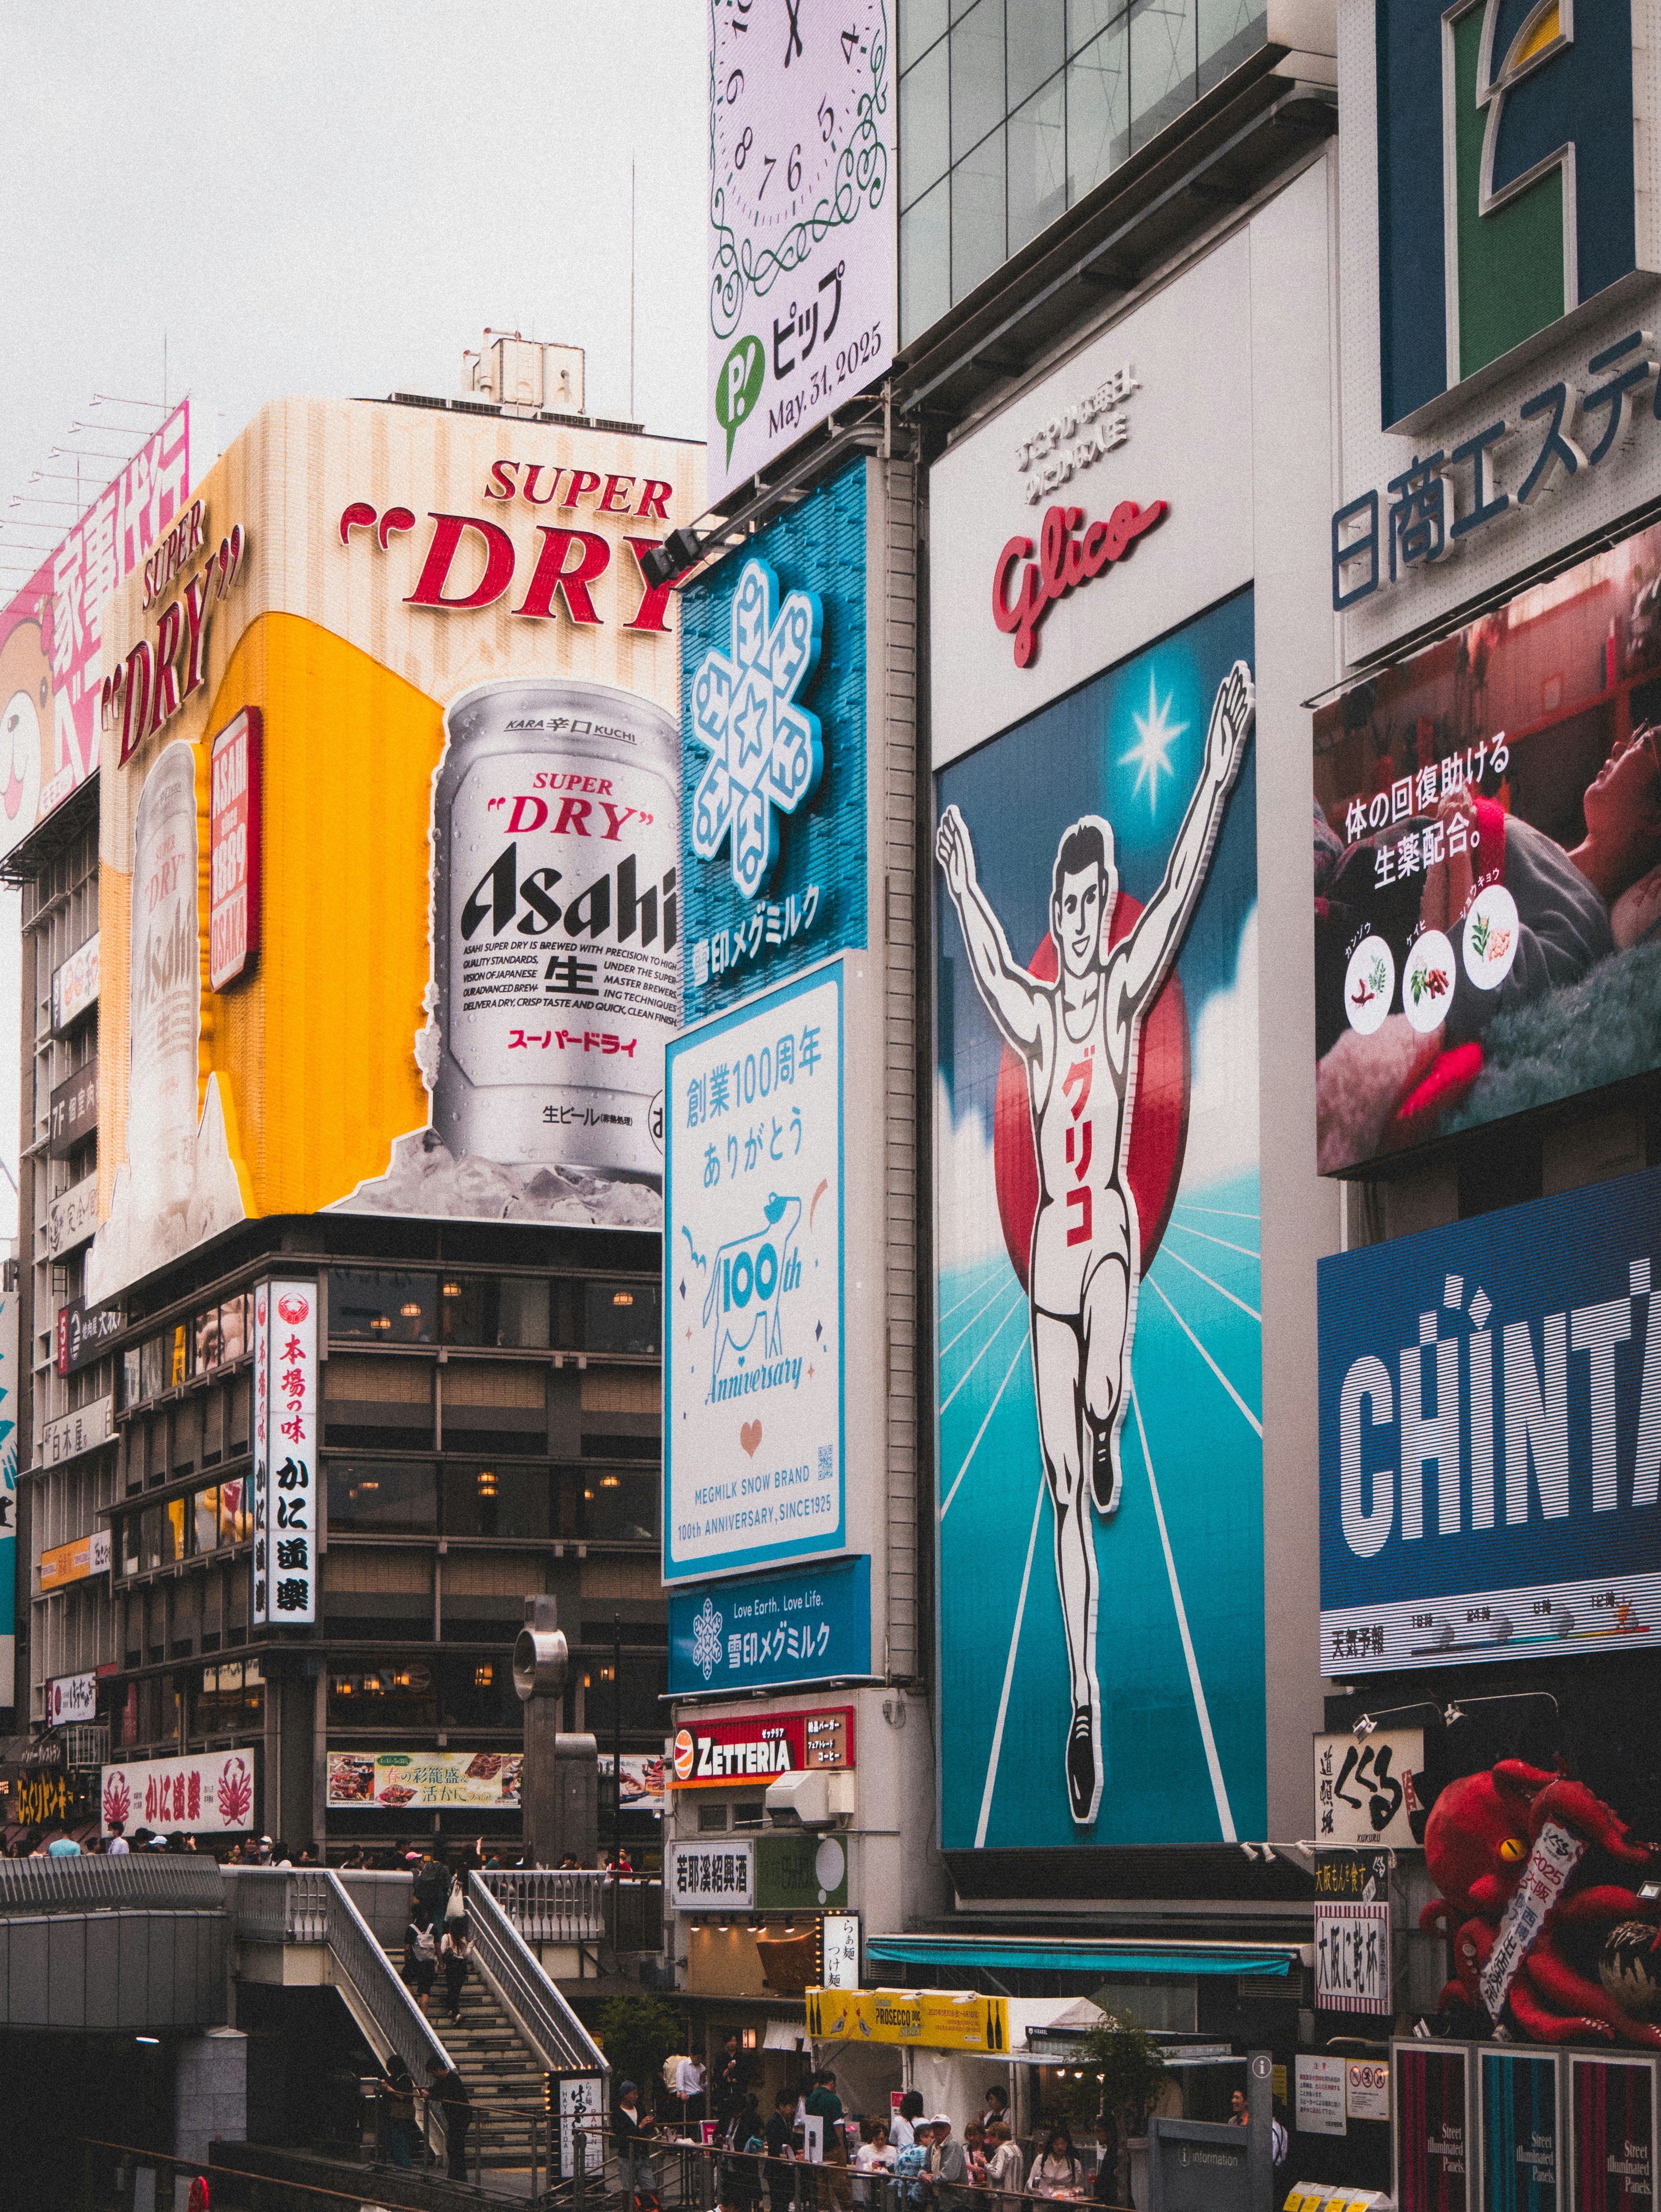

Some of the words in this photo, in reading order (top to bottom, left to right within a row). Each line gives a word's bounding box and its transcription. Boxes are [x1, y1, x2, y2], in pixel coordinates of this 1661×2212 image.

[841, 23, 859, 65] 4
[726, 69, 745, 104] 9
[817, 93, 834, 142] 5
[735, 126, 752, 170] 8
[787, 143, 802, 192] 6
[759, 157, 776, 200] 7
[773, 260, 845, 380] ピップ
[769, 391, 808, 438] May.
[810, 364, 833, 406] 31,
[836, 322, 882, 384] 2025
[484, 460, 673, 520] SUPER
[1331, 329, 1661, 612] 日商エステ
[52, 407, 186, 677] 家事代行
[142, 499, 207, 613] SUPER
[992, 500, 1167, 669] Glico
[505, 718, 544, 731] KARA
[547, 716, 592, 735] 辛口
[593, 724, 637, 743] KUCHI
[213, 733, 247, 818] ASAHI
[533, 772, 614, 796] SUPER
[1345, 731, 1509, 844] 体の回復助ける
[221, 806, 237, 837] since
[213, 823, 246, 905] 1889
[1374, 811, 1480, 890] 生薬配合。
[461, 842, 676, 954] Asahi
[212, 895, 244, 976] OSAKA
[692, 883, 820, 987] 雪印メグミルク
[1345, 921, 1371, 959] カンゾウ
[1406, 920, 1426, 947] ケイヒ
[463, 944, 483, 955] ASAHI
[484, 942, 509, 951] SUPER
[511, 941, 527, 950] DRY
[530, 941, 538, 949] IS
[540, 942, 577, 951] BREWED
[580, 944, 603, 954] WITH
[605, 948, 648, 962] PRECISION
[650, 956, 660, 964] TO
[661, 960, 677, 970] HIGH
[463, 957, 491, 969] QUALITY
[491, 956, 539, 966] STANDARDS,
[604, 961, 635, 974] UNDER
[637, 967, 653, 978] THE
[463, 972, 485, 983] VISION
[486, 972, 496, 980] OF
[495, 970, 537, 979] JAPANESE
[463, 988, 475, 997] OUR
[475, 985, 514, 996] ADVANCED
[544, 956, 599, 996] 生
[604, 975, 642, 990] MASTER
[463, 1000, 492, 1011] DELIVER
[498, 999, 515, 1008] DRY,
[516, 999, 542, 1007] CRISP
[543, 999, 570, 1008] TASTE
[572, 1001, 594, 1010] AND
[595, 1002, 626, 1015] QUICK,
[627, 1008, 654, 1020] CLEAN
[604, 989, 623, 999] ING
[624, 992, 677, 1012] TECHNIQUES
[508, 1029, 637, 1058] スーパードライ
[686, 1024, 822, 1129] 創業100周年
[52, 1101, 65, 1140] 7F
[703, 1106, 803, 1188] ありがとう
[1062, 1044, 1095, 1248] グリコ
[723, 1242, 802, 1314] 100th
[61, 1317, 66, 1368] 5F
[257, 1334, 266, 1446] 本場の味
[279, 1334, 306, 1446] 本場の味
[705, 1355, 803, 1406] Anniversary
[53, 1419, 82, 1462] 白木屋
[695, 1481, 737, 1506] MEGMILK
[741, 1474, 770, 1496] SNOW
[775, 1465, 810, 1488] BRAND
[678, 1522, 701, 1541] 100th
[734, 1603, 752, 1618] Love
[754, 1598, 779, 1616] Earth.
[783, 1595, 803, 1611] Love
[805, 1590, 823, 1608] Life.
[728, 1620, 830, 1669] 雪印メグミルク
[762, 1728, 784, 1738] ゼッテリア
[808, 1720, 840, 1734] 絶品バーガー
[808, 1739, 833, 1750] フェアトレード
[698, 1737, 791, 1777] ZETTERIA
[818, 1751, 841, 1762] コーヒー
[1319, 1744, 1333, 1836] 道頓堀
[1357, 1833, 1381, 1843] KUKURU
[1532, 1850, 1565, 1886] 2025
[842, 1920, 855, 1961] らぁ麺
[827, 1945, 841, 1988] つけ麺
[876, 2008, 910, 2027] PROSECCO
[1442, 2123, 1462, 2140] Street
[1531, 2132, 1552, 2149] Street
[1624, 2140, 1648, 2159] Street
[1192, 2152, 1238, 2167] information
[1443, 2157, 1465, 2173] Panels.
[1533, 2167, 1555, 2184] Panels.
[1625, 2176, 1651, 2195] Panels.
